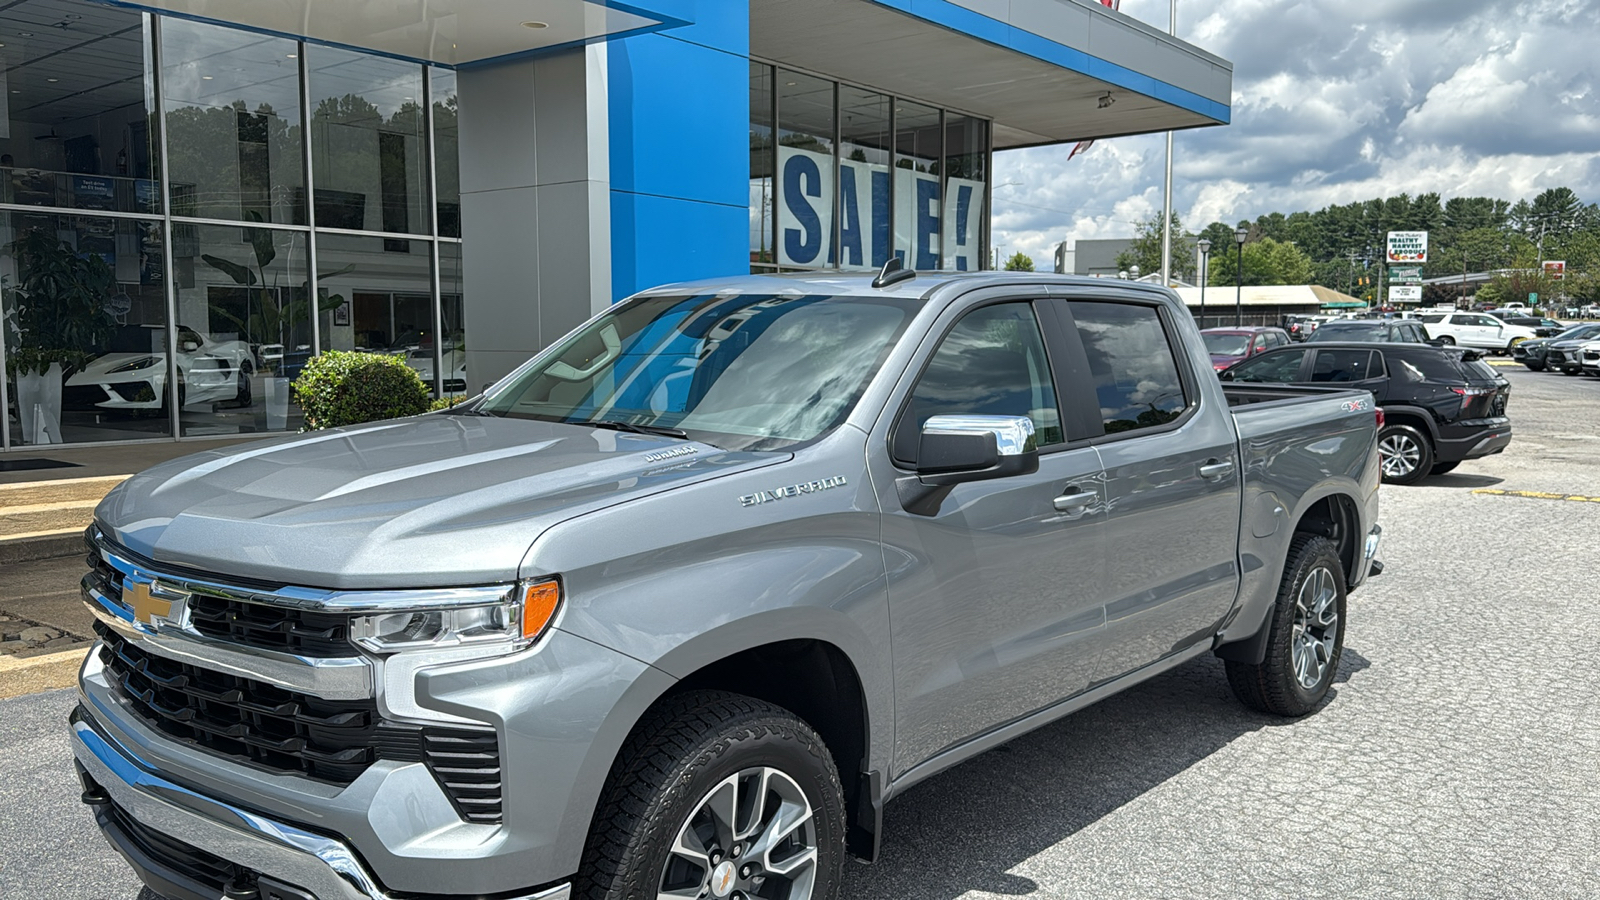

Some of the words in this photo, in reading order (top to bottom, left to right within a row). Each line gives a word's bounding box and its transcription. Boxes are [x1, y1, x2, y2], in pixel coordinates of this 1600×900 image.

[783, 154, 973, 271] SALE!
[645, 445, 698, 463] DURAMAX
[739, 475, 848, 507] SILVERADO
